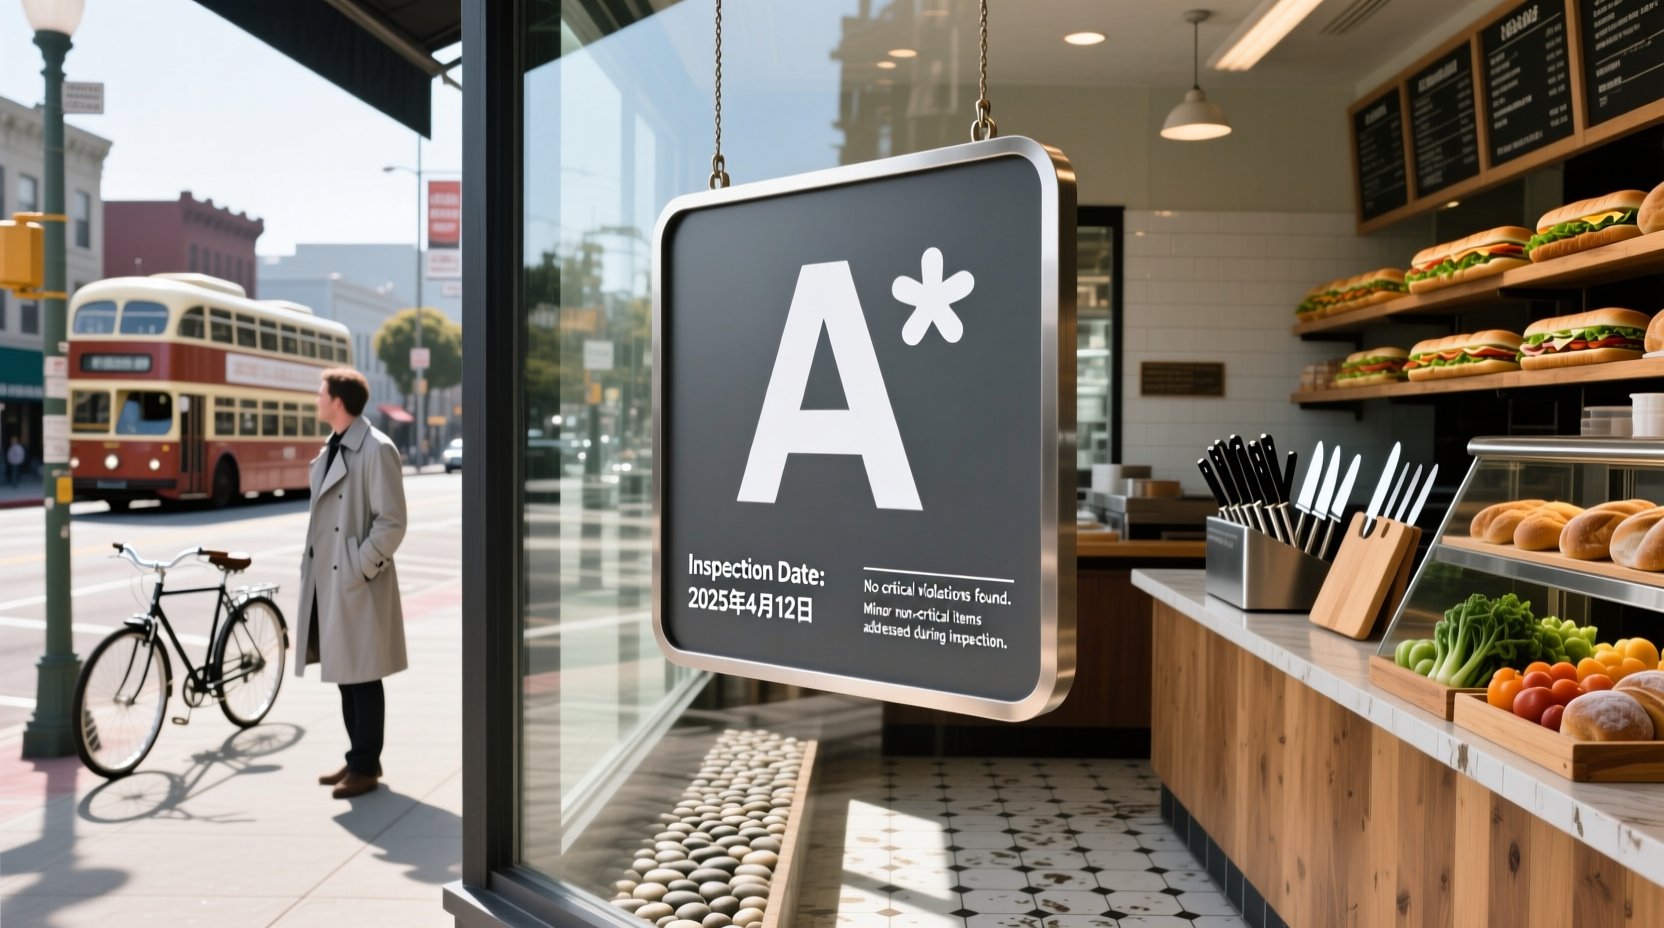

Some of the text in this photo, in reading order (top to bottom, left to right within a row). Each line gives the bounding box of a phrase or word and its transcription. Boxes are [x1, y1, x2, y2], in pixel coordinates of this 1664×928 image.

[688, 553, 825, 587] Inspection Date:
[863, 579, 879, 593] No
[974, 588, 1012, 605] found.
[688, 587, 813, 624] 2025年4月12日
[863, 602, 892, 617] Minor
[952, 610, 982, 625] items
[914, 625, 946, 646] during
